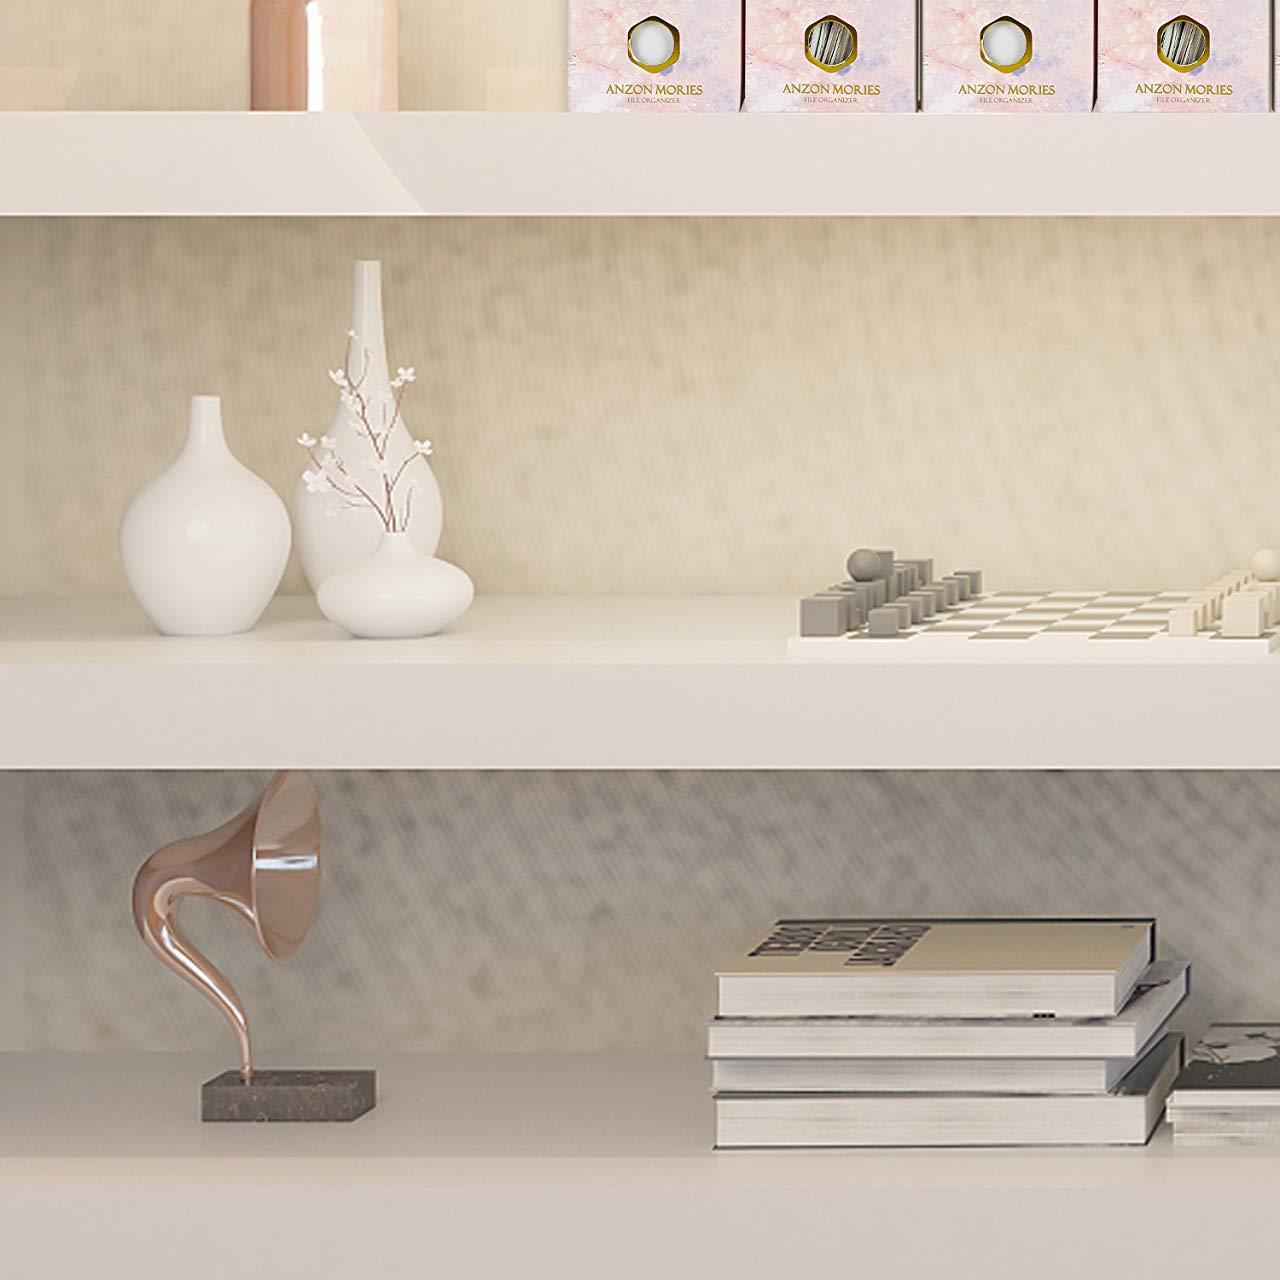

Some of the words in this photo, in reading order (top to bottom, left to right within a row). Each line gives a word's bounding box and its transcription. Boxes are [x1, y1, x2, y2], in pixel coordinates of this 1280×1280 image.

[606, 84, 653, 95] ANZON
[655, 84, 703, 95] MORIES
[782, 84, 830, 95] ANZON
[832, 84, 881, 95] MORIES
[958, 84, 1005, 95] ANZON
[1007, 84, 1056, 95] MORIES
[1135, 84, 1182, 95] ANZON
[1184, 84, 1233, 95] MORIES
